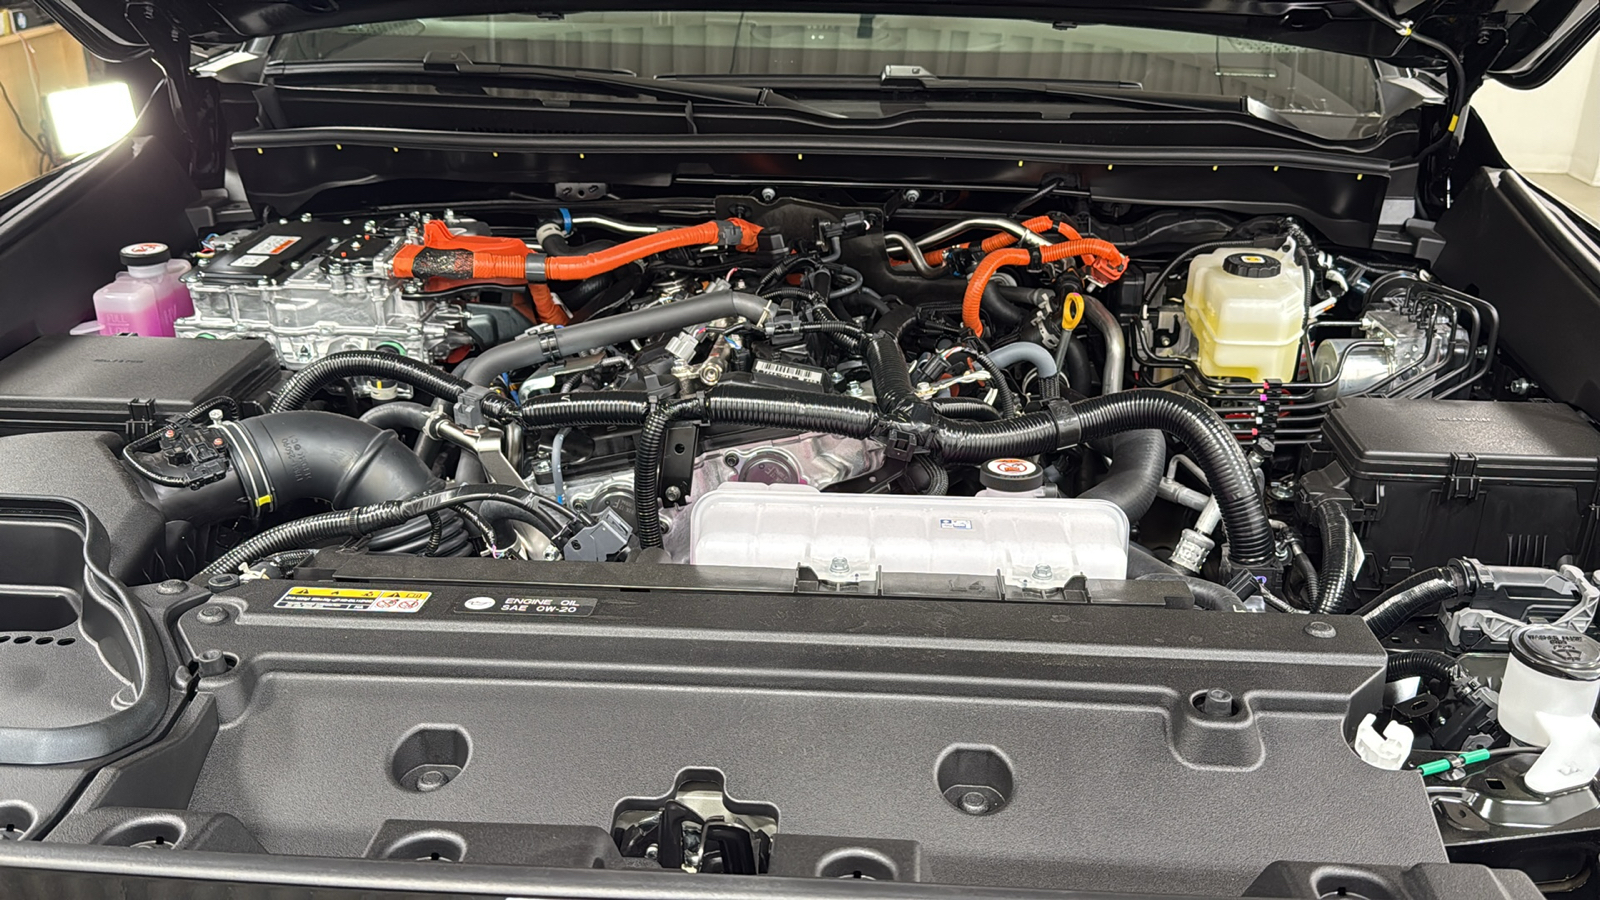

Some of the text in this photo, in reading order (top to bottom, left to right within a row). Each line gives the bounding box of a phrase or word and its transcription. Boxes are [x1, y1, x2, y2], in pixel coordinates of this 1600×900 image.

[505, 597, 580, 607] ENGINE OIL
[501, 604, 577, 613] SAE 0W-20
